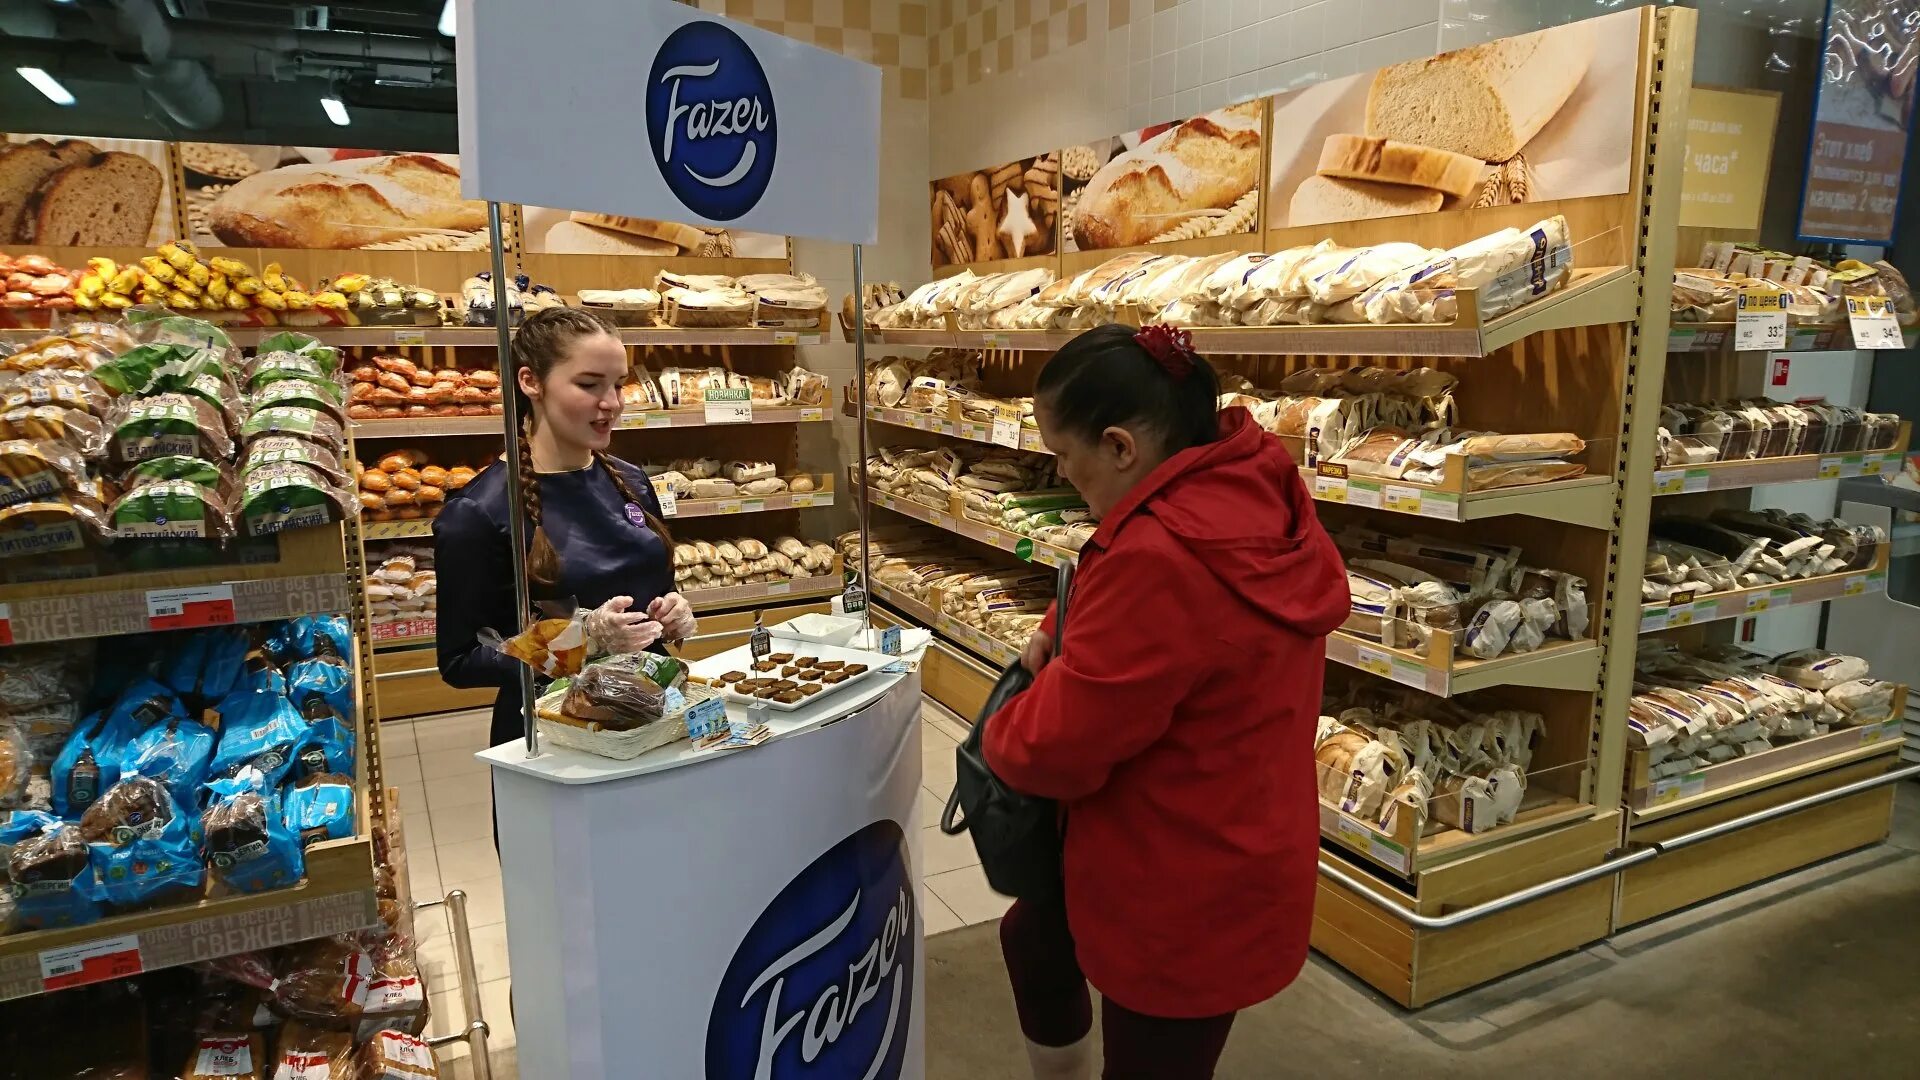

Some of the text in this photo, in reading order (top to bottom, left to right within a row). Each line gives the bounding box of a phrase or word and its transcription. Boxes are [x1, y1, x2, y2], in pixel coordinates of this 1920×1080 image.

[661, 58, 769, 163] Fazer
[1815, 132, 1874, 161] Этот хлеб
[1858, 187, 1869, 212] 2
[1739, 294, 1746, 309] 2
[1749, 296, 1757, 306] по
[1759, 295, 1777, 308] цене
[1768, 326, 1778, 338] 33
[1883, 327, 1893, 338] 34
[709, 389, 746, 400] НОВИНКА!
[734, 408, 744, 416] 34
[127, 441, 193, 459] БАЛТИЙСКИЙ
[254, 512, 324, 536] БАЛТИЙСКИЙ
[18, 598, 79, 616] ВСЕГДА
[9, 613, 81, 642] ЕЖЕЕ
[98, 613, 150, 634] ДЕНЬГ
[239, 903, 295, 926] ВСЕГДА
[192, 920, 297, 958] СВЕЖЕЕ
[740, 887, 910, 1080] Fazer
[214, 1055, 234, 1063] ХЛЕБ
